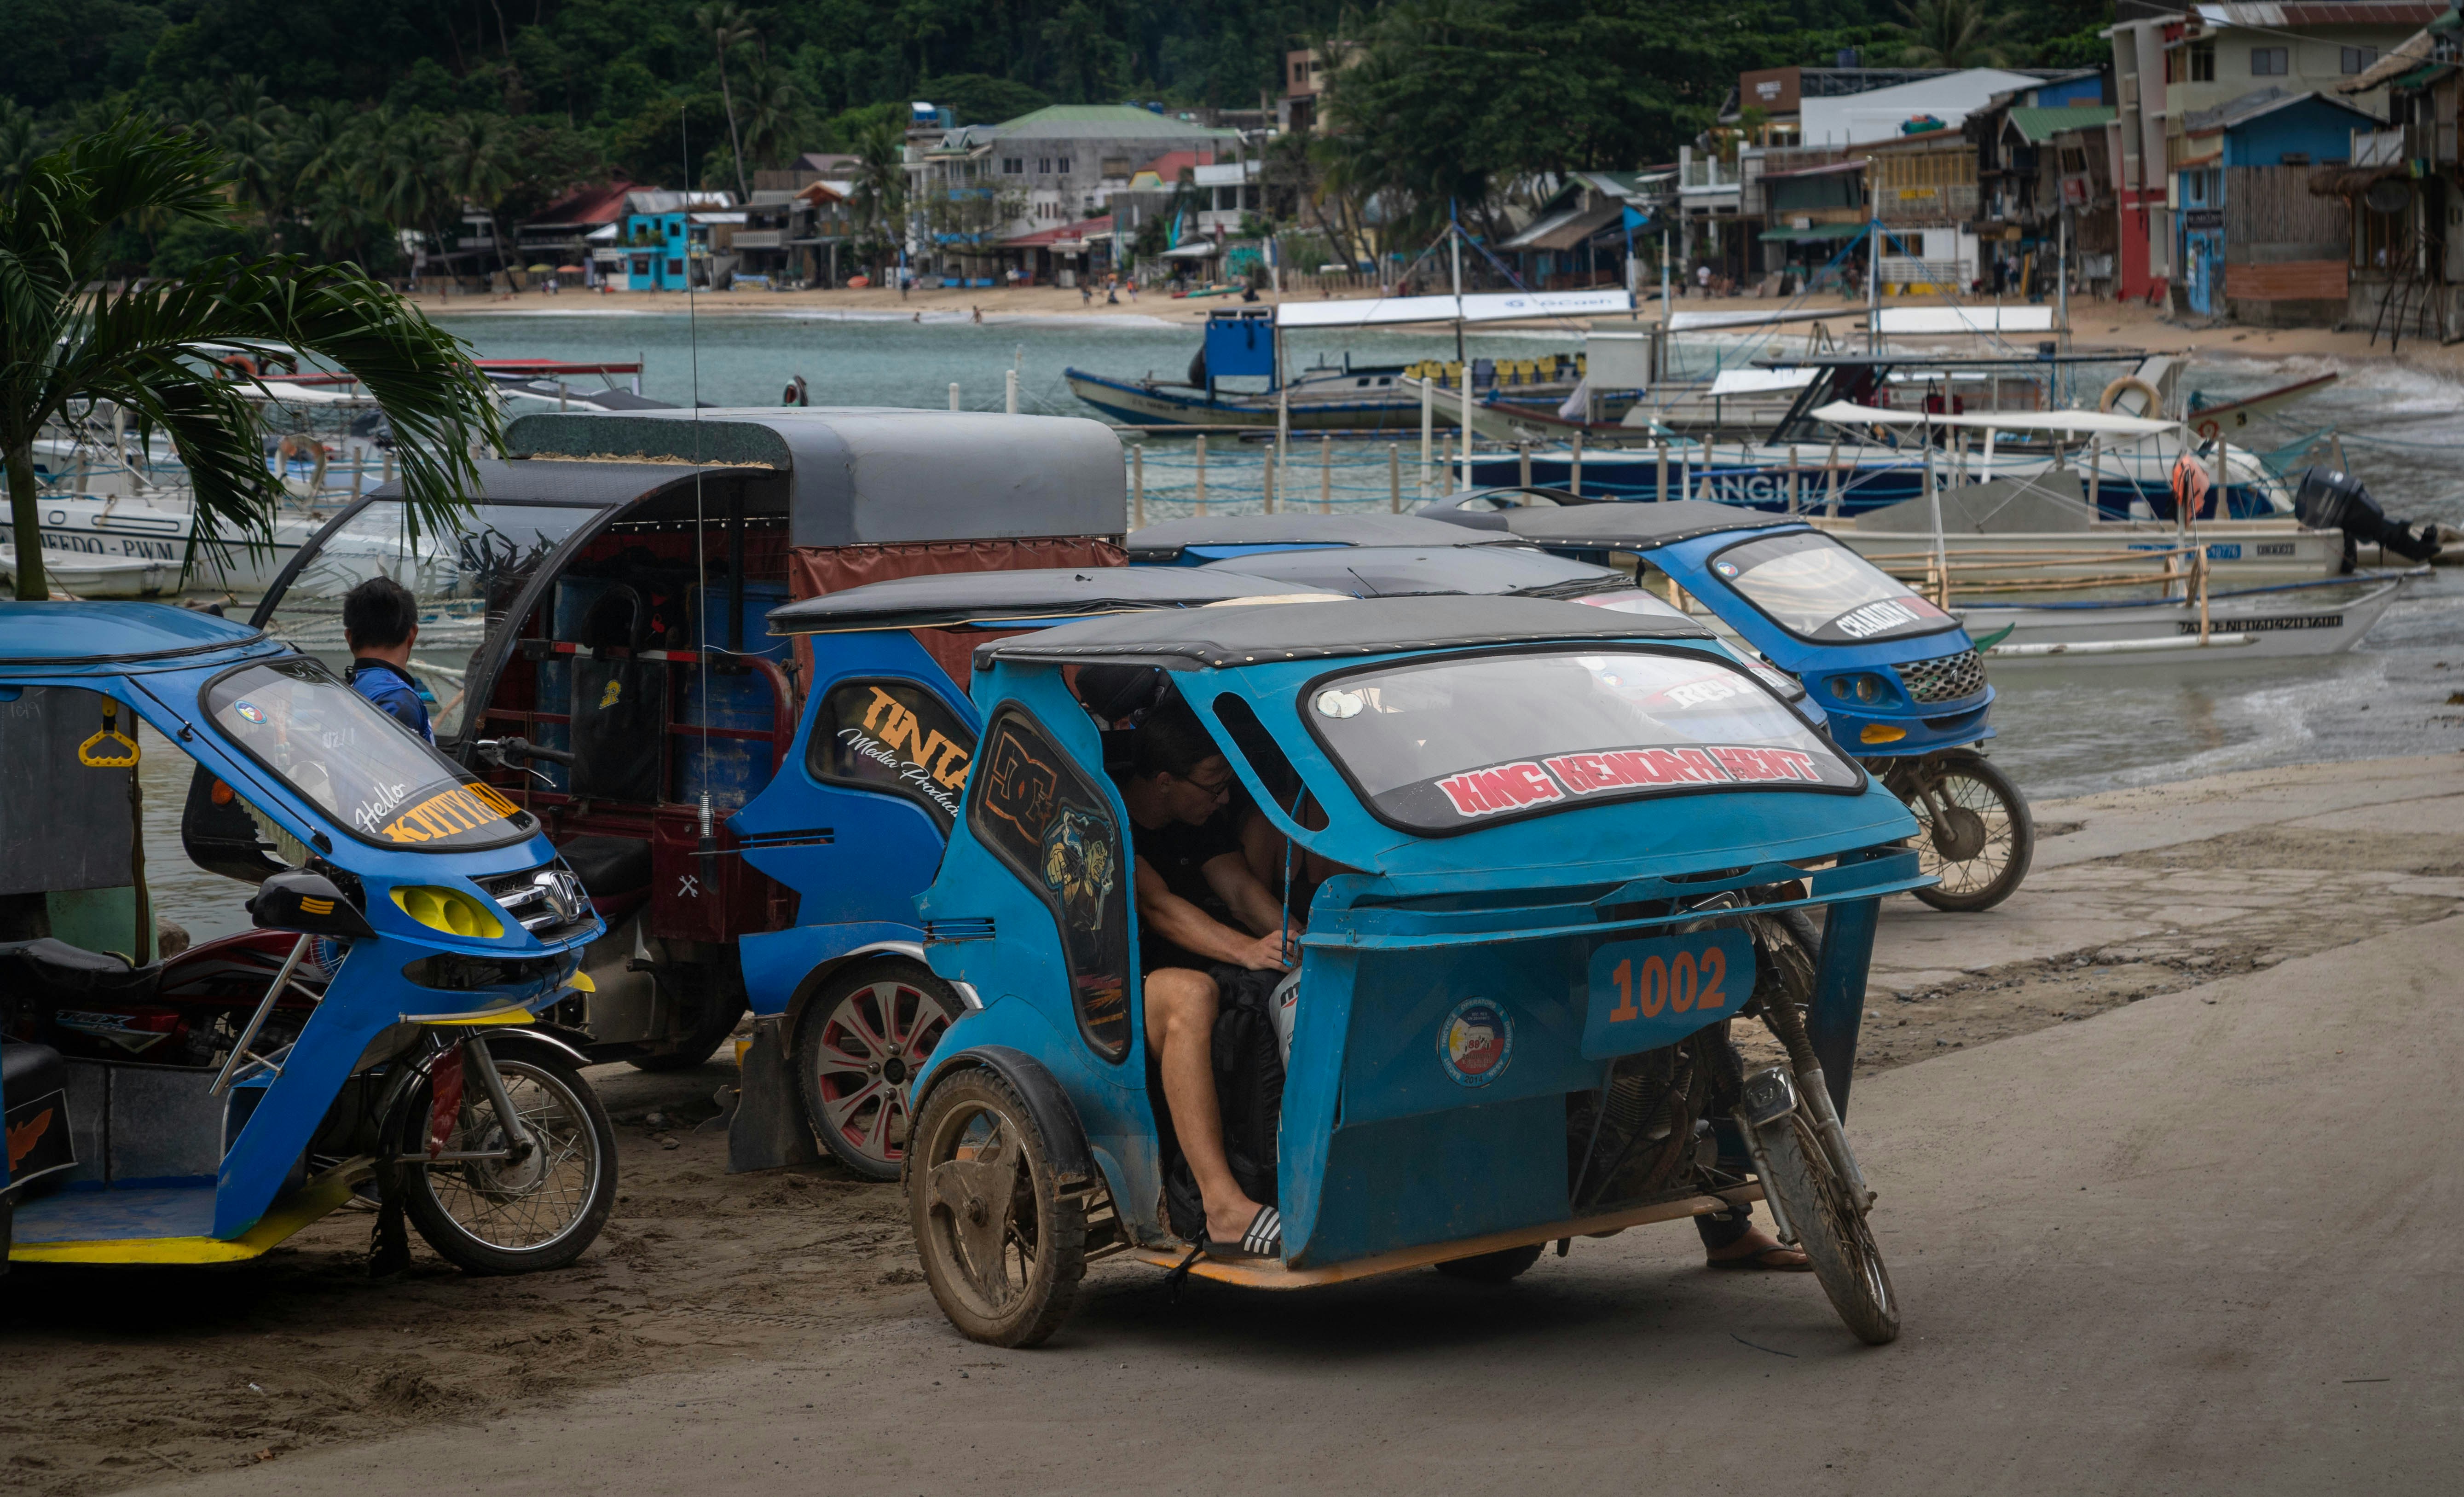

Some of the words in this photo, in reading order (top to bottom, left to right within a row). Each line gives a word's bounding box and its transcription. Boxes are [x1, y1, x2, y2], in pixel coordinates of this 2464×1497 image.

[838, 729, 899, 768] Media
[900, 762, 959, 818] Produc
[1435, 762, 1565, 816] KING
[1543, 748, 1727, 794] KENDRA
[1709, 746, 1822, 783] KENT
[355, 782, 407, 834] Hello
[1610, 947, 1727, 1023] 1002
[55, 1010, 136, 1027] TMX
[1441, 1012, 1458, 1047] TRICYCLE
[1461, 999, 1497, 1009] OPERATORS
